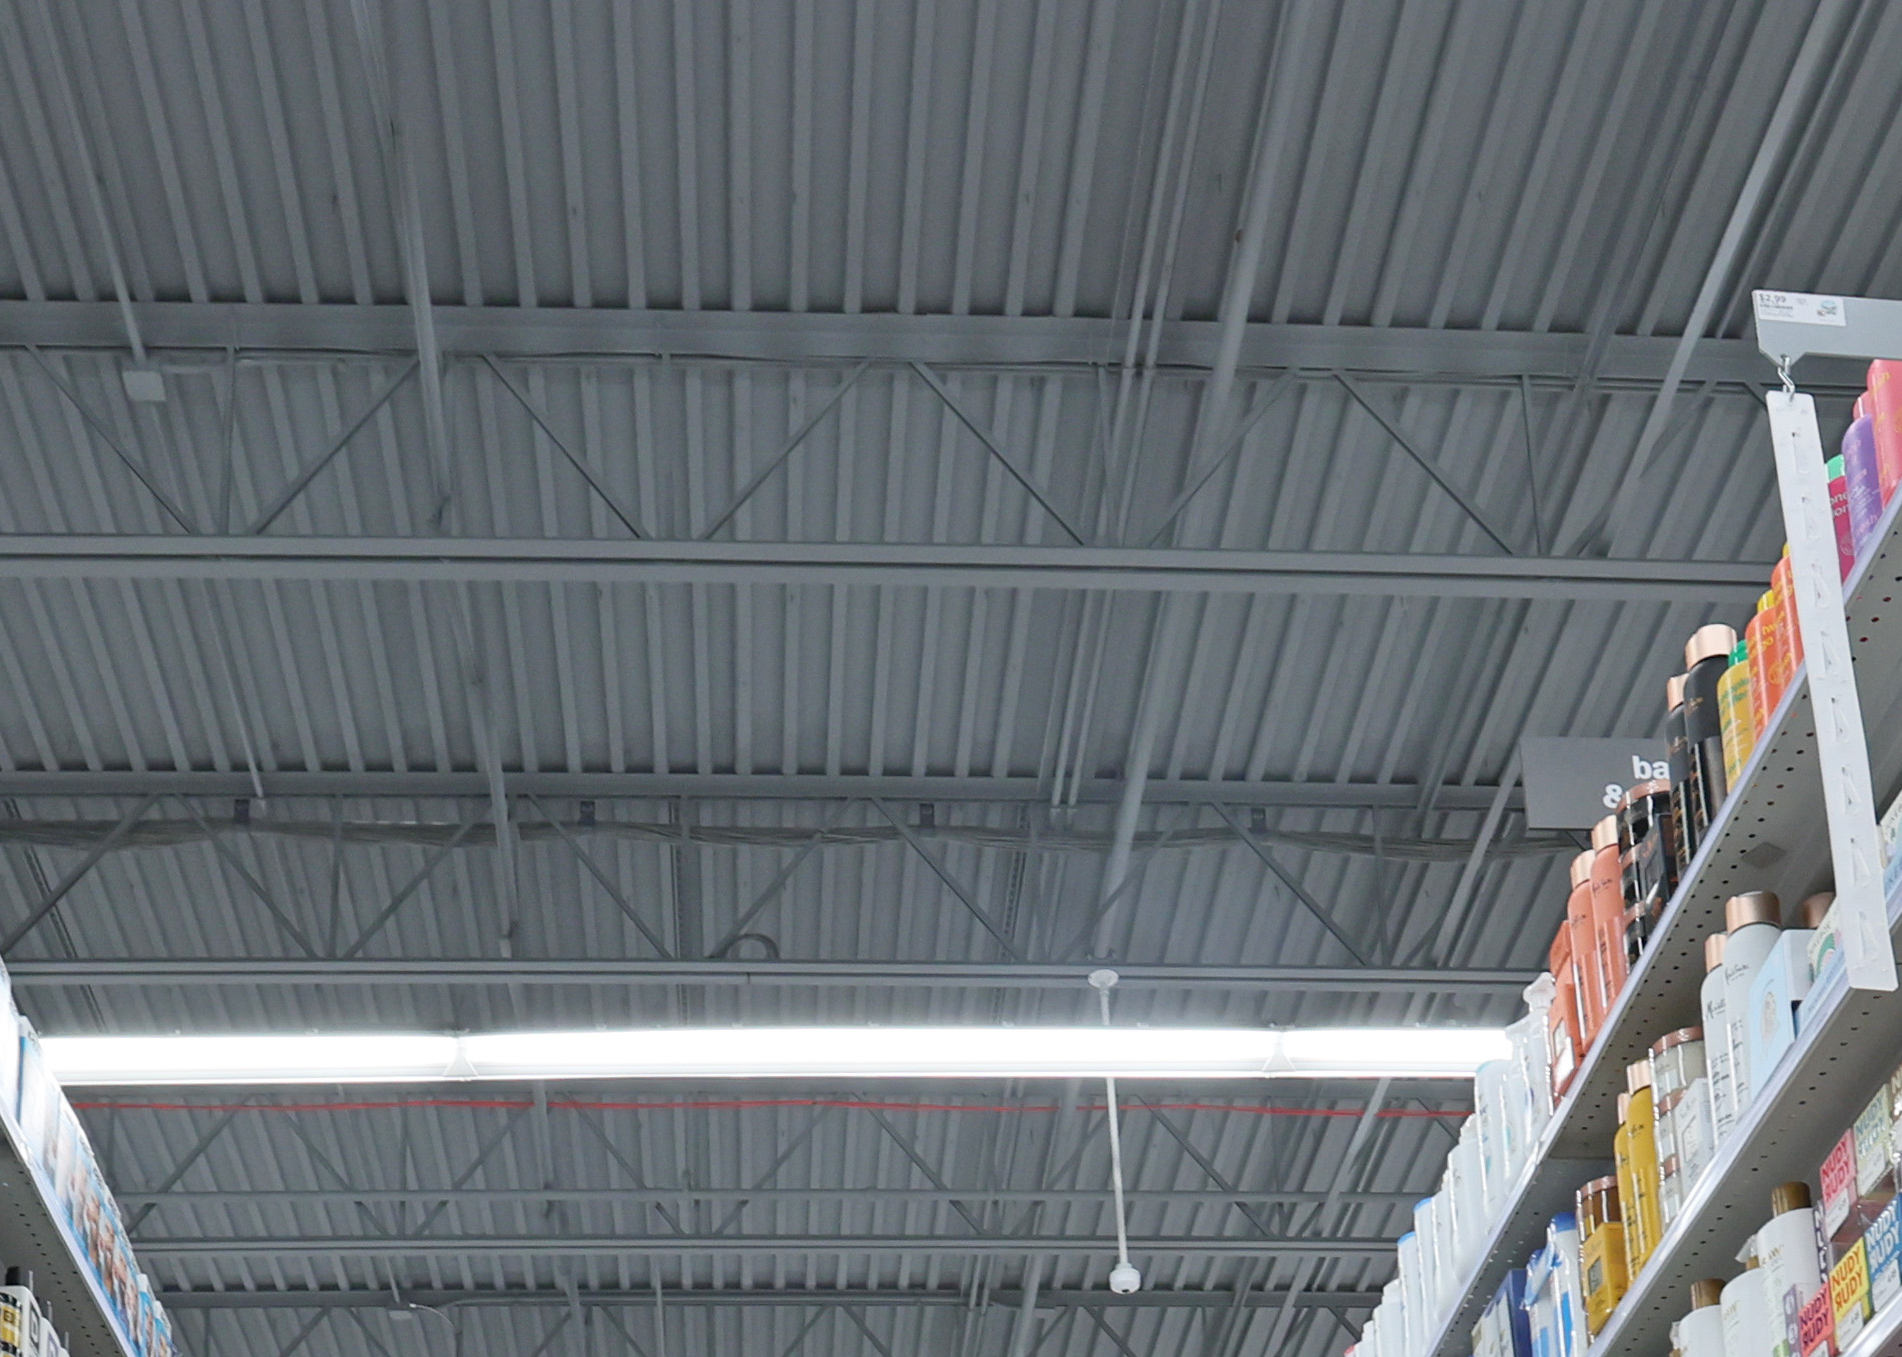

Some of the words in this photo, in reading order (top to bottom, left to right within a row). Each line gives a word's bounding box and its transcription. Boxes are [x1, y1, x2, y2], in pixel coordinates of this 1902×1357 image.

[1603, 784, 1622, 808] &
[1822, 1141, 1849, 1182] NUDY
[1866, 1202, 1897, 1248] NUDY
[1830, 1246, 1862, 1292] NUDY
